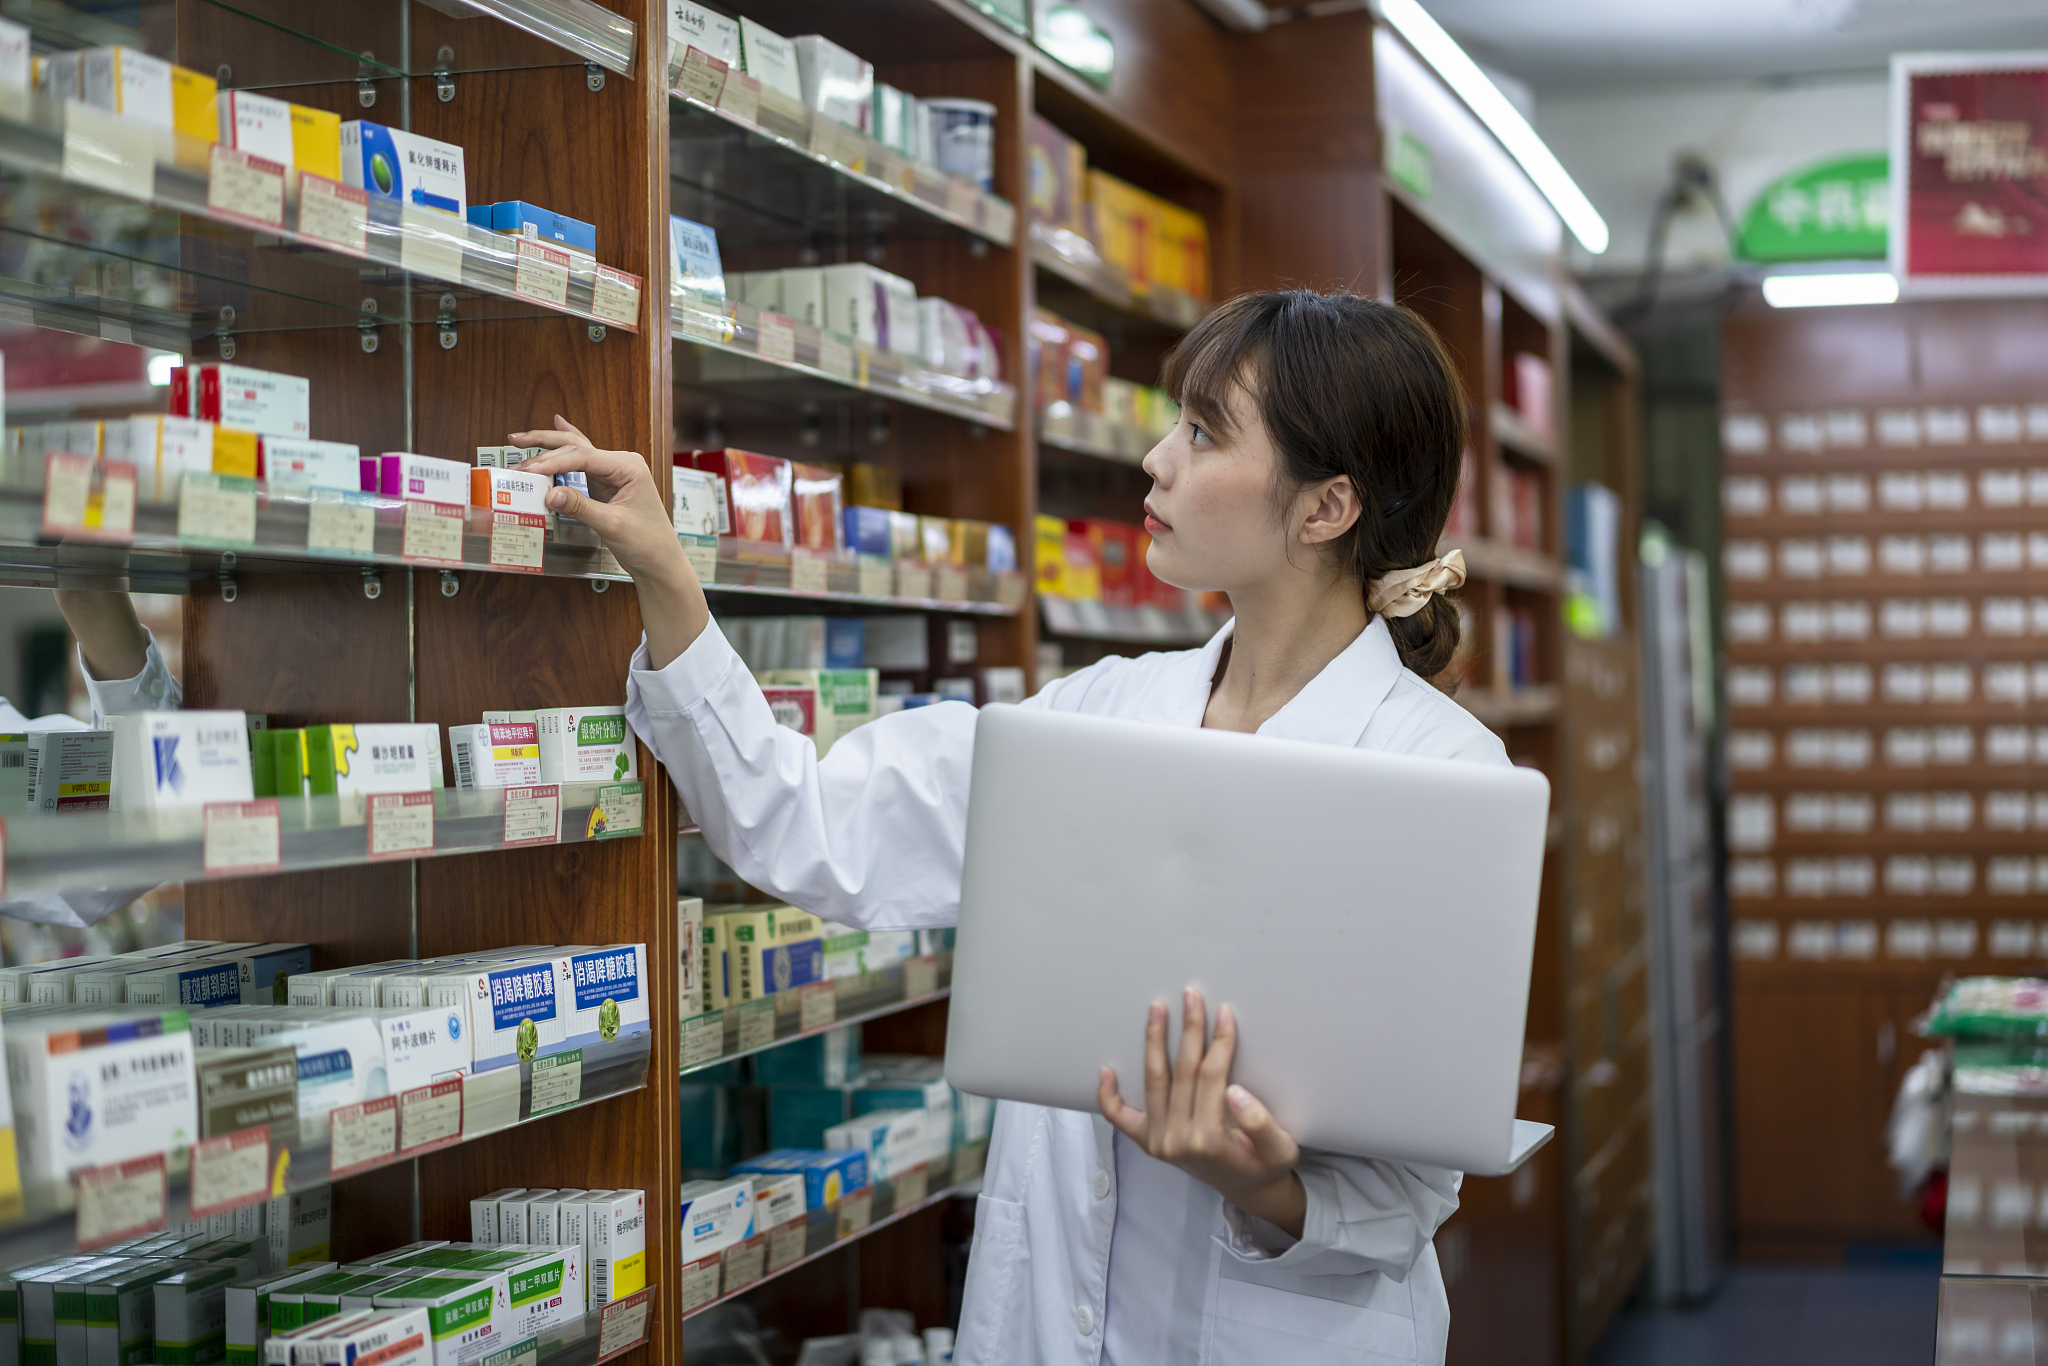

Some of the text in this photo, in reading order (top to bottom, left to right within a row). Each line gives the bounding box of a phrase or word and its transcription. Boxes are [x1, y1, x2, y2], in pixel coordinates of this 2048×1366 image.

[493, 727, 534, 740] 硝苯地平控释片
[581, 721, 623, 740] 银杏叶分散片
[574, 952, 636, 987] 消渴降糖胶囊
[491, 970, 554, 1006] 消渴降糖胶囊
[391, 1028, 436, 1052] 阿卡波糖片
[513, 1267, 560, 1295] 盐酸二甲双胍片
[445, 1295, 490, 1325] 盐酸二甲双胍片
